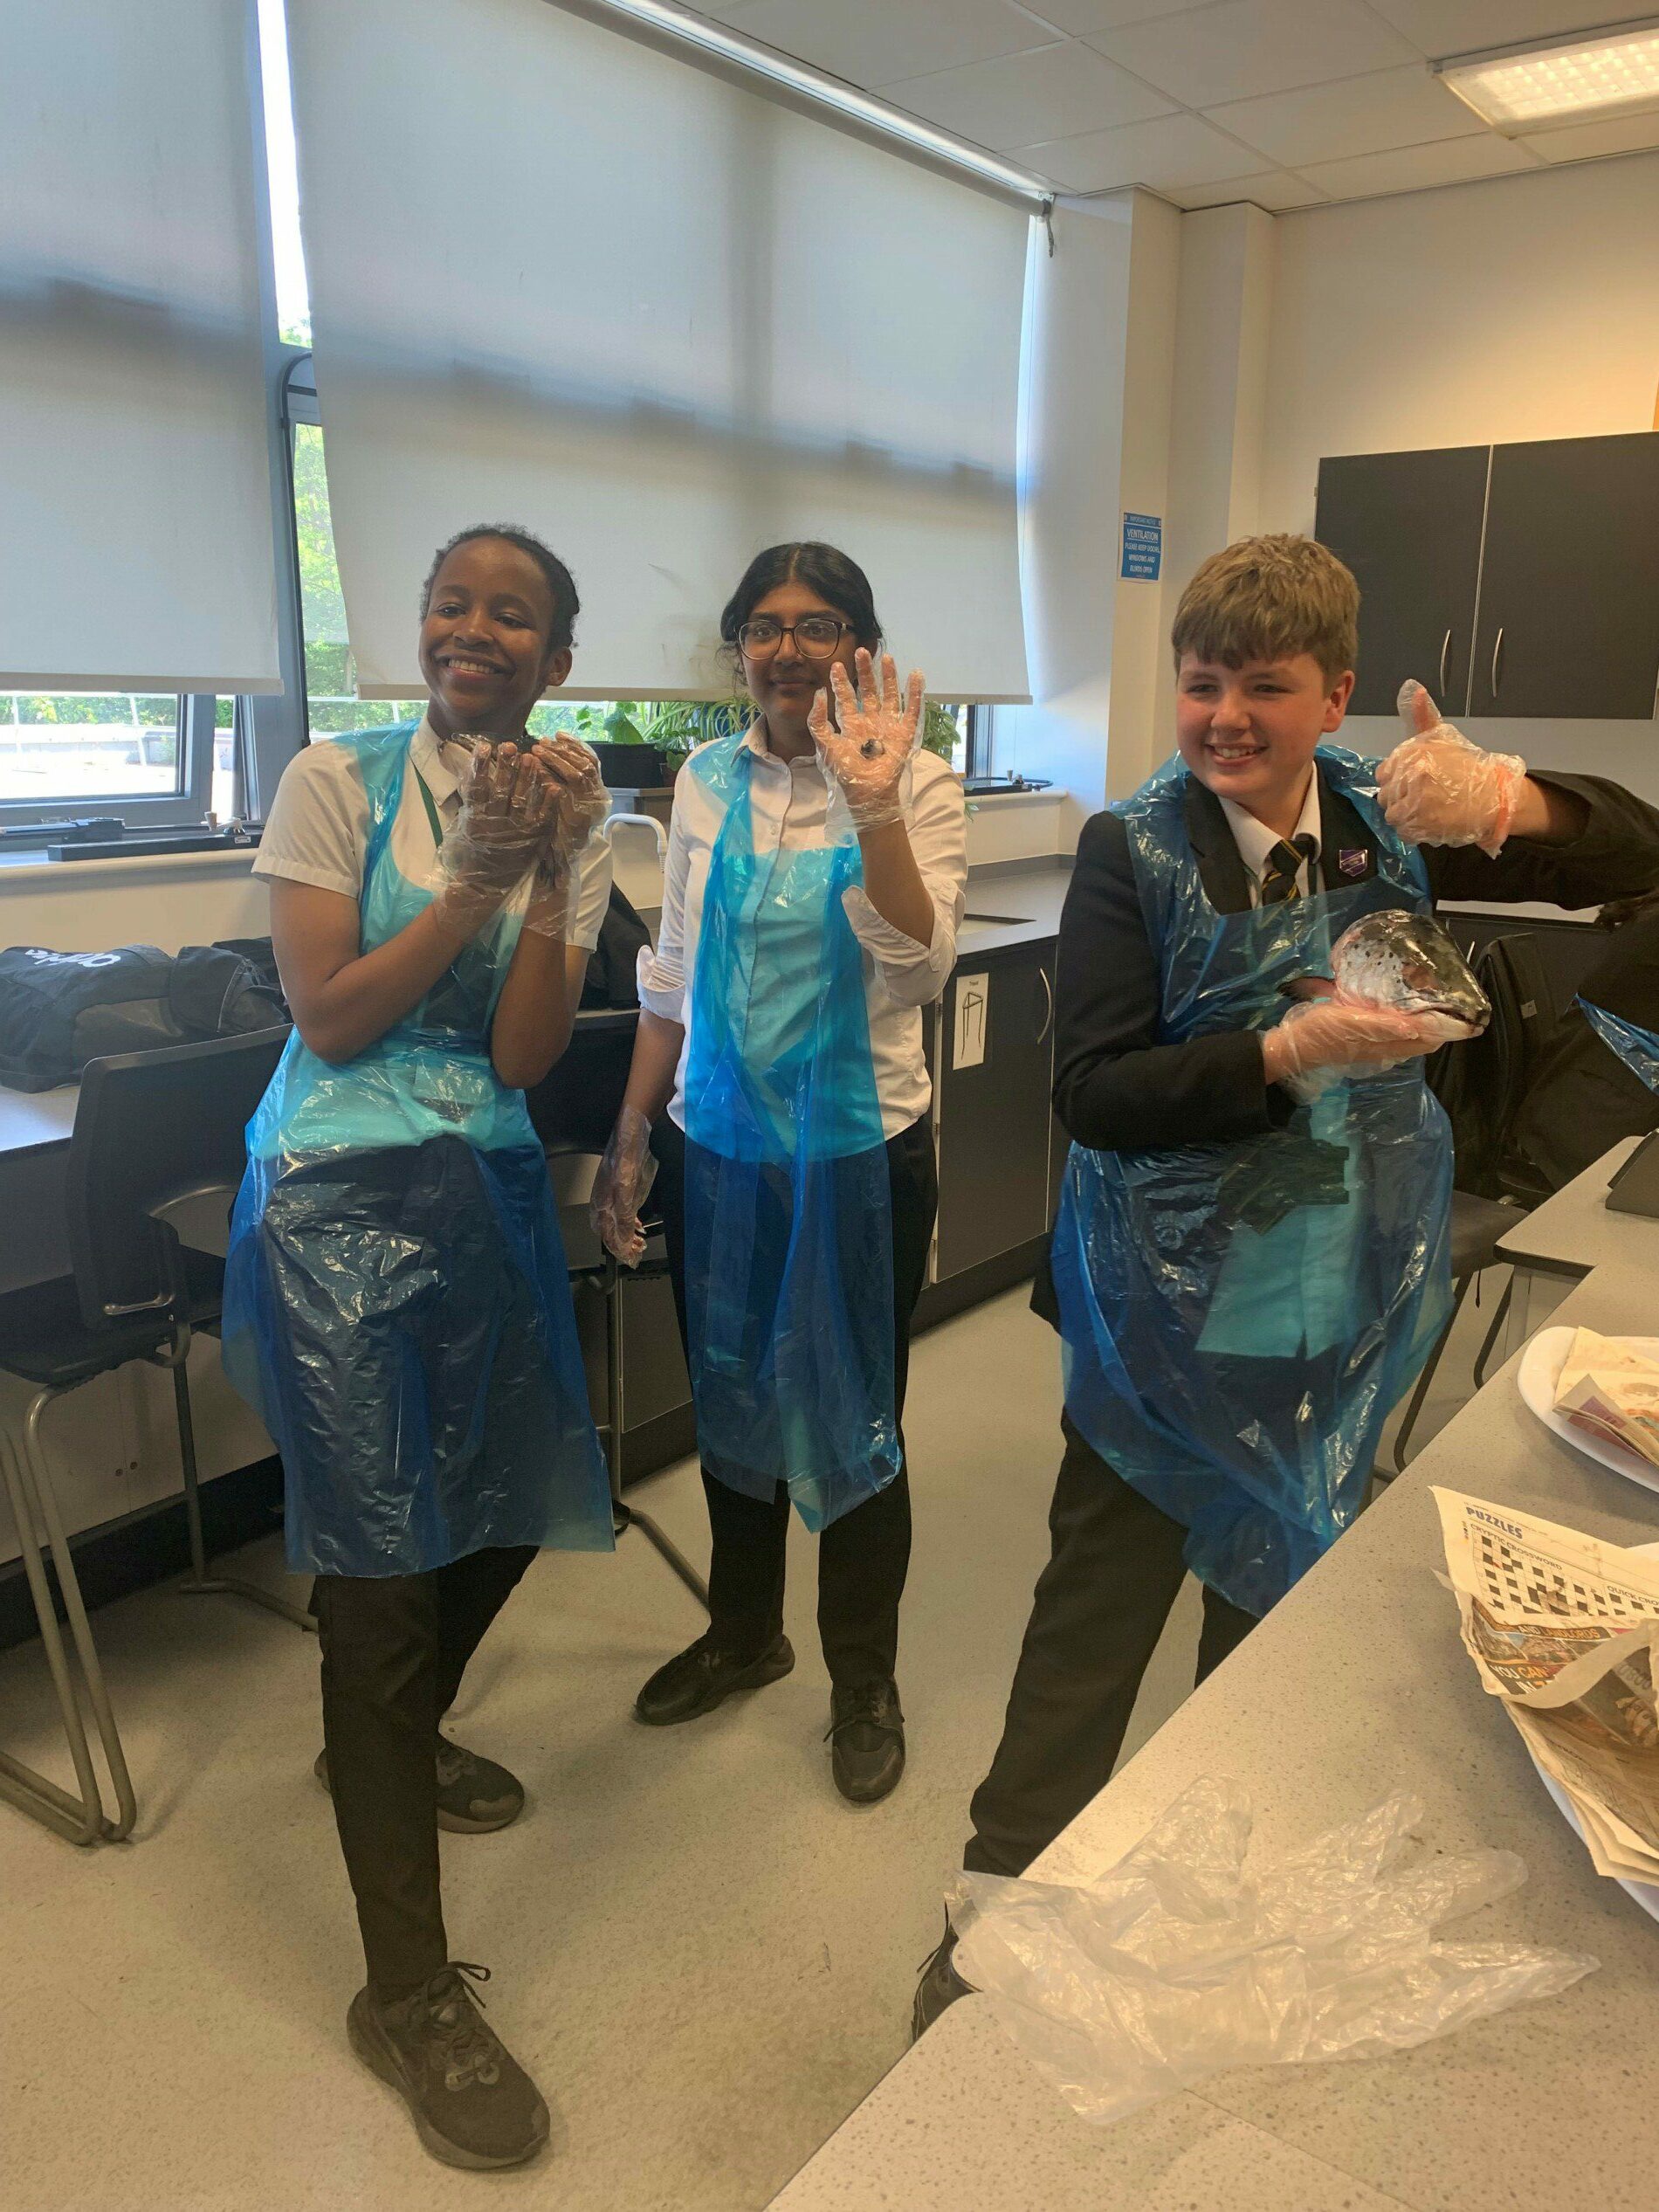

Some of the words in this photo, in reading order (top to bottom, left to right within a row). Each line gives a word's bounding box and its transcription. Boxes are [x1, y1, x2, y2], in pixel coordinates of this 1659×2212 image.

[1126, 528, 1159, 541] VENTILATION
[1465, 1506, 1523, 1540] PUZZLES
[1470, 1523, 1507, 1547] CRYPTIC
[1506, 1540, 1562, 1570] CROSSWORD
[1607, 1586, 1637, 1600] QUICK
[1638, 1596, 1659, 1606] CRO
[1518, 1625, 1540, 1635] AND
[1544, 1627, 1600, 1639] LANDLORDS
[1490, 1664, 1520, 1678] YOU
